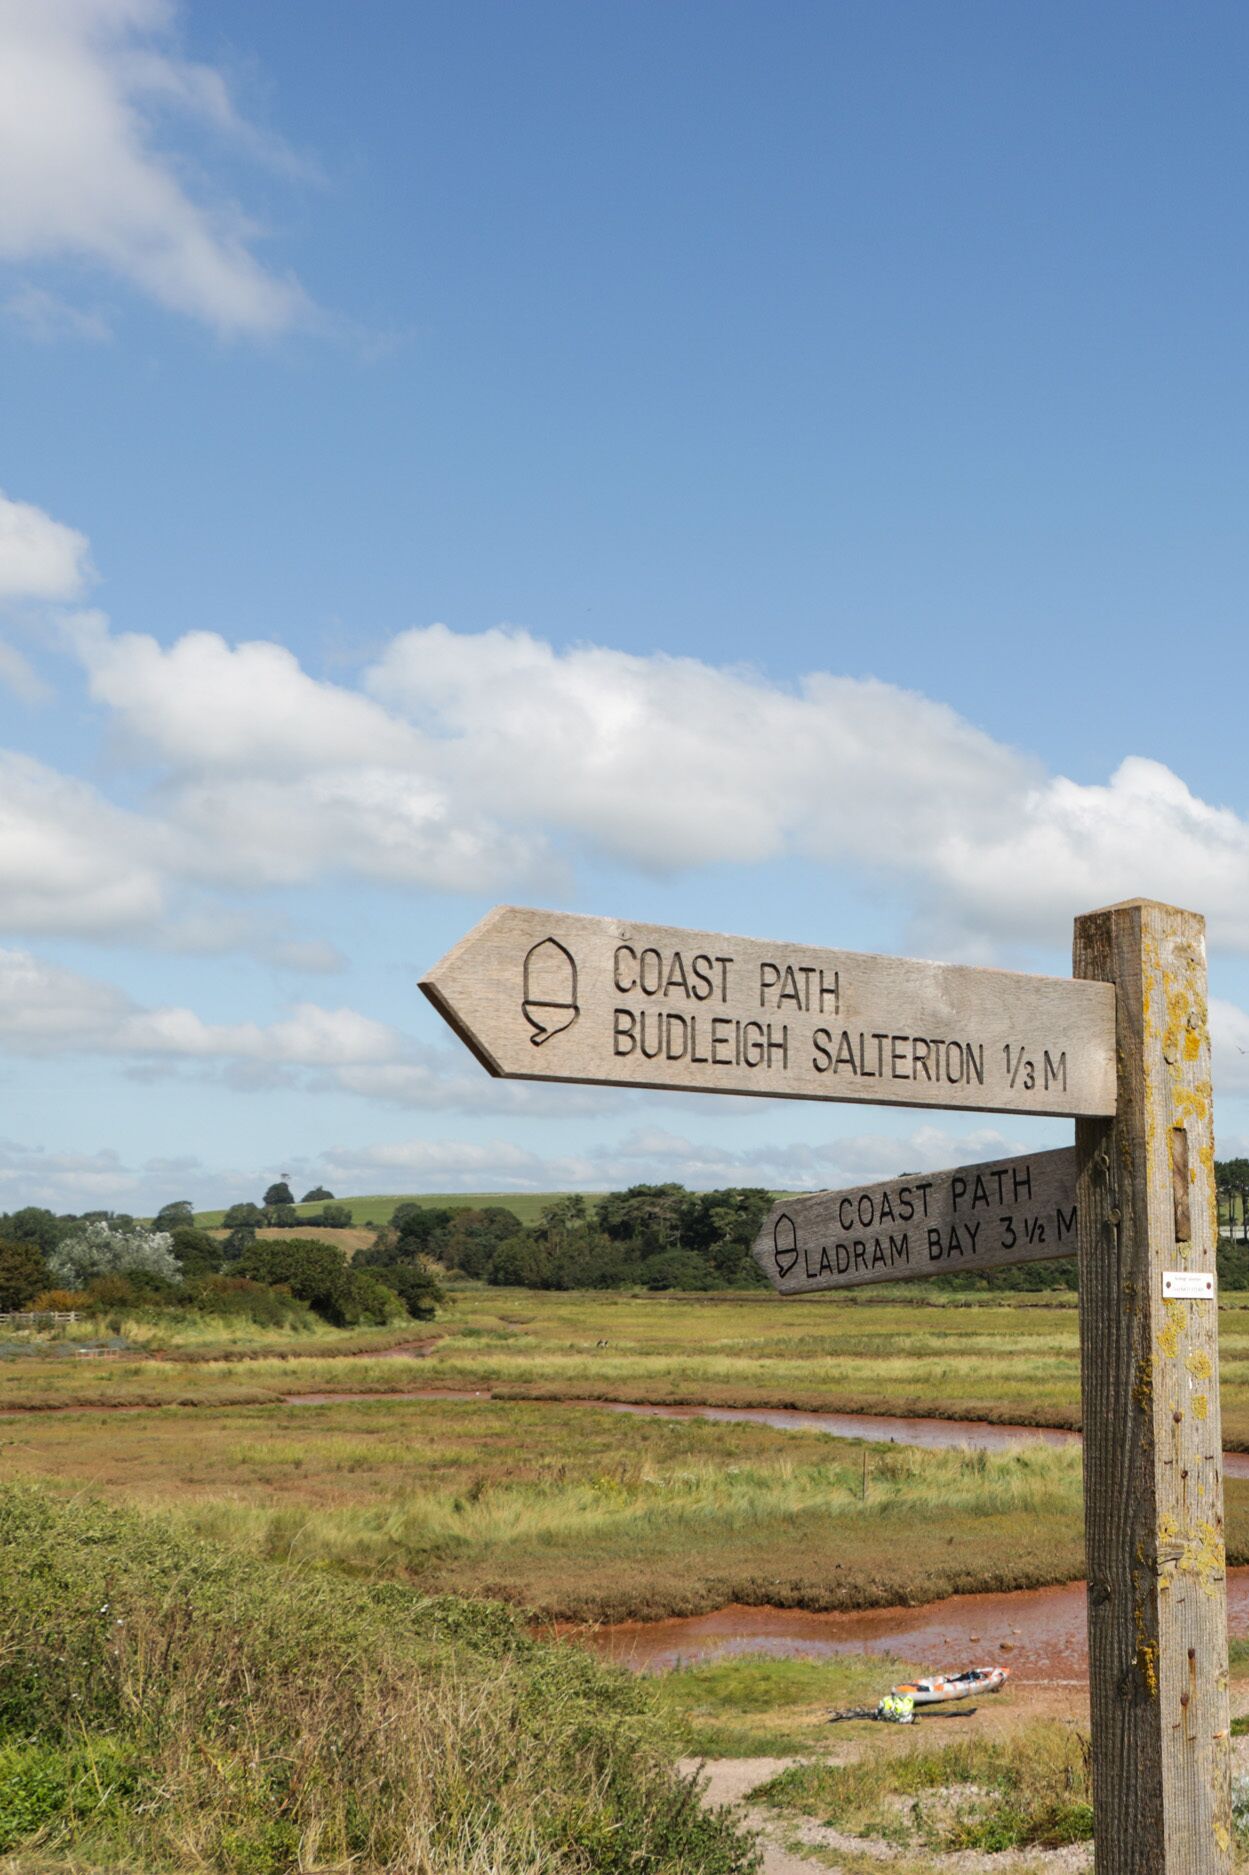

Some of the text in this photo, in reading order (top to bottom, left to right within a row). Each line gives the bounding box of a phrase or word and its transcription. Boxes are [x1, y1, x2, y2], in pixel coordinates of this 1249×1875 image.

[614, 944, 840, 1015] COAST PATH
[614, 1008, 788, 1070] BUDLEIGH
[812, 1028, 984, 1085] SALTERTON
[1043, 1050, 1067, 1092] M
[838, 1165, 1032, 1231] COAST PATH
[804, 1233, 910, 1278] LADRAM
[927, 1221, 981, 1261] BAY
[1056, 1205, 1078, 1241] M
